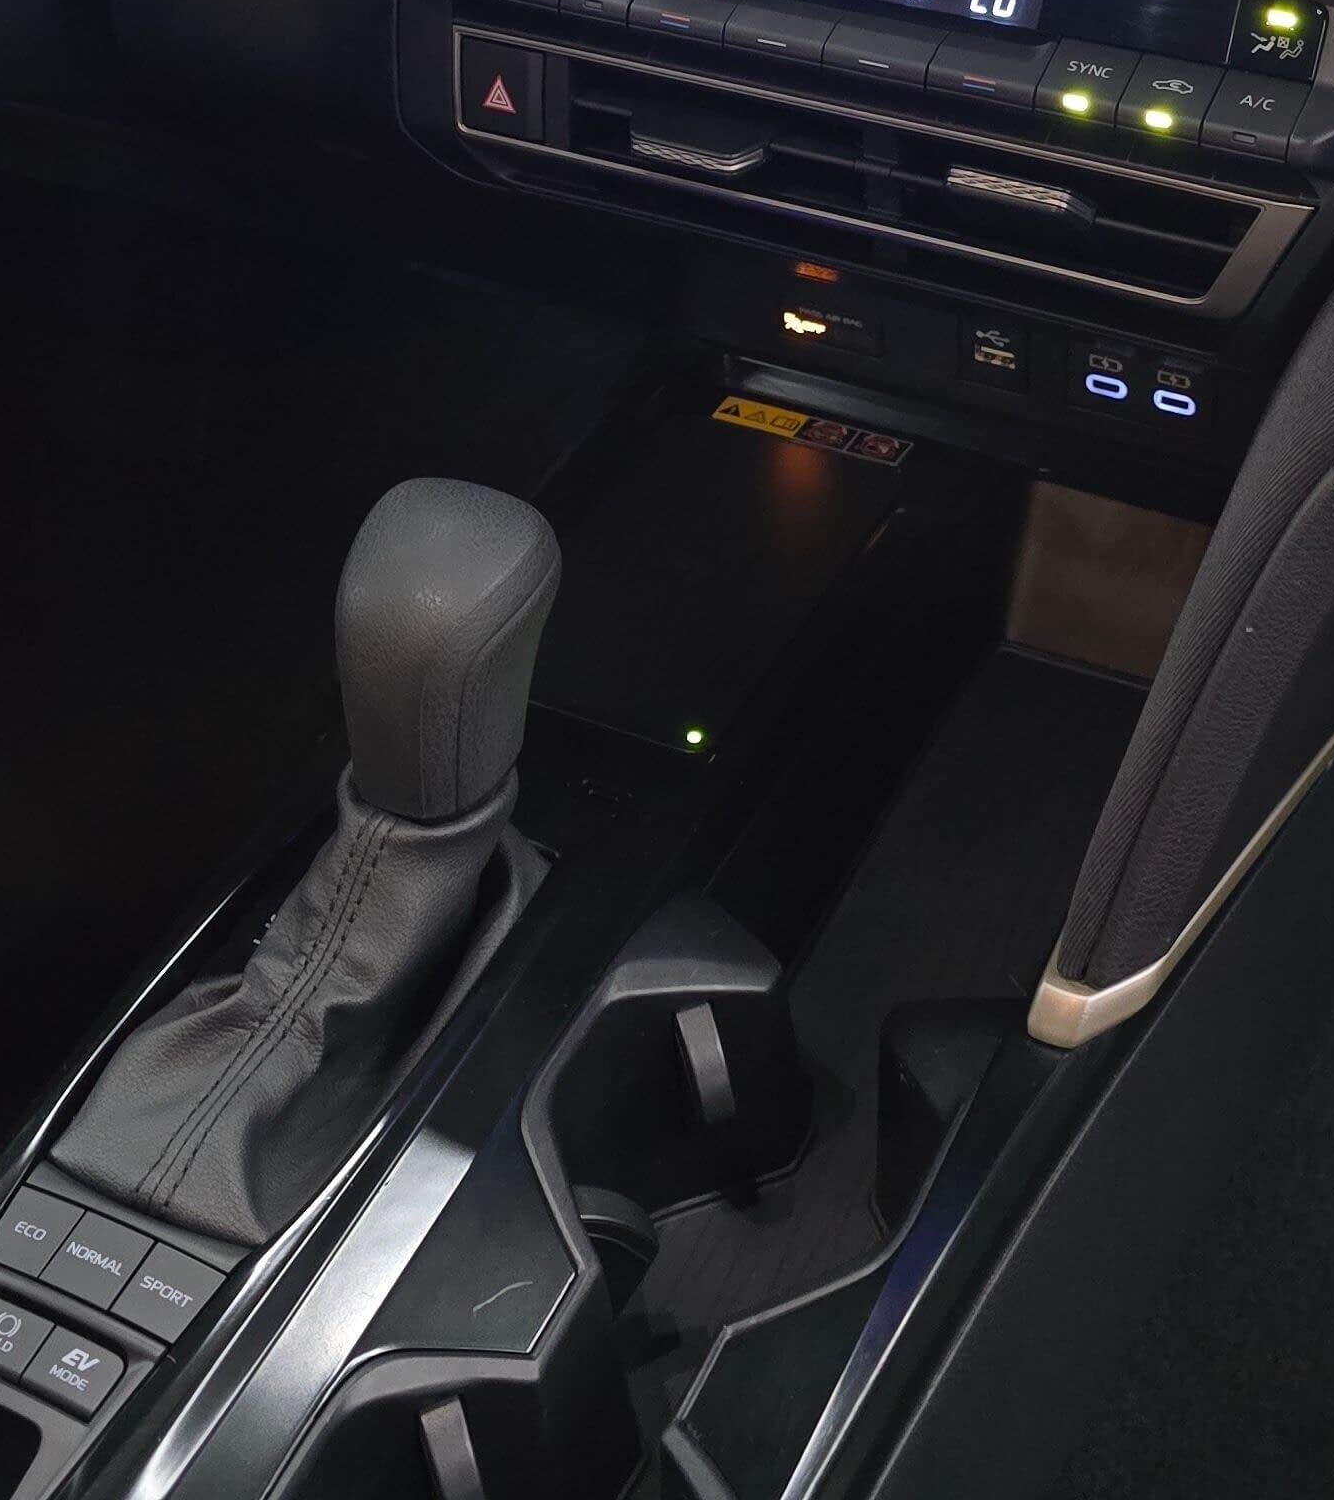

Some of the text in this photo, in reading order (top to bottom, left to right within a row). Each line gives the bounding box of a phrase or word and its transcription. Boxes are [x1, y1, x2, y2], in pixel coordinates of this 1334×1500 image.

[1067, 59, 1115, 80] SYNC
[1239, 94, 1276, 113] A/C
[13, 1220, 47, 1242] ECO
[65, 1240, 123, 1277] NORMAL
[139, 1275, 194, 1309] SPORT
[60, 1348, 100, 1373] EV
[48, 1363, 90, 1392] MODE
